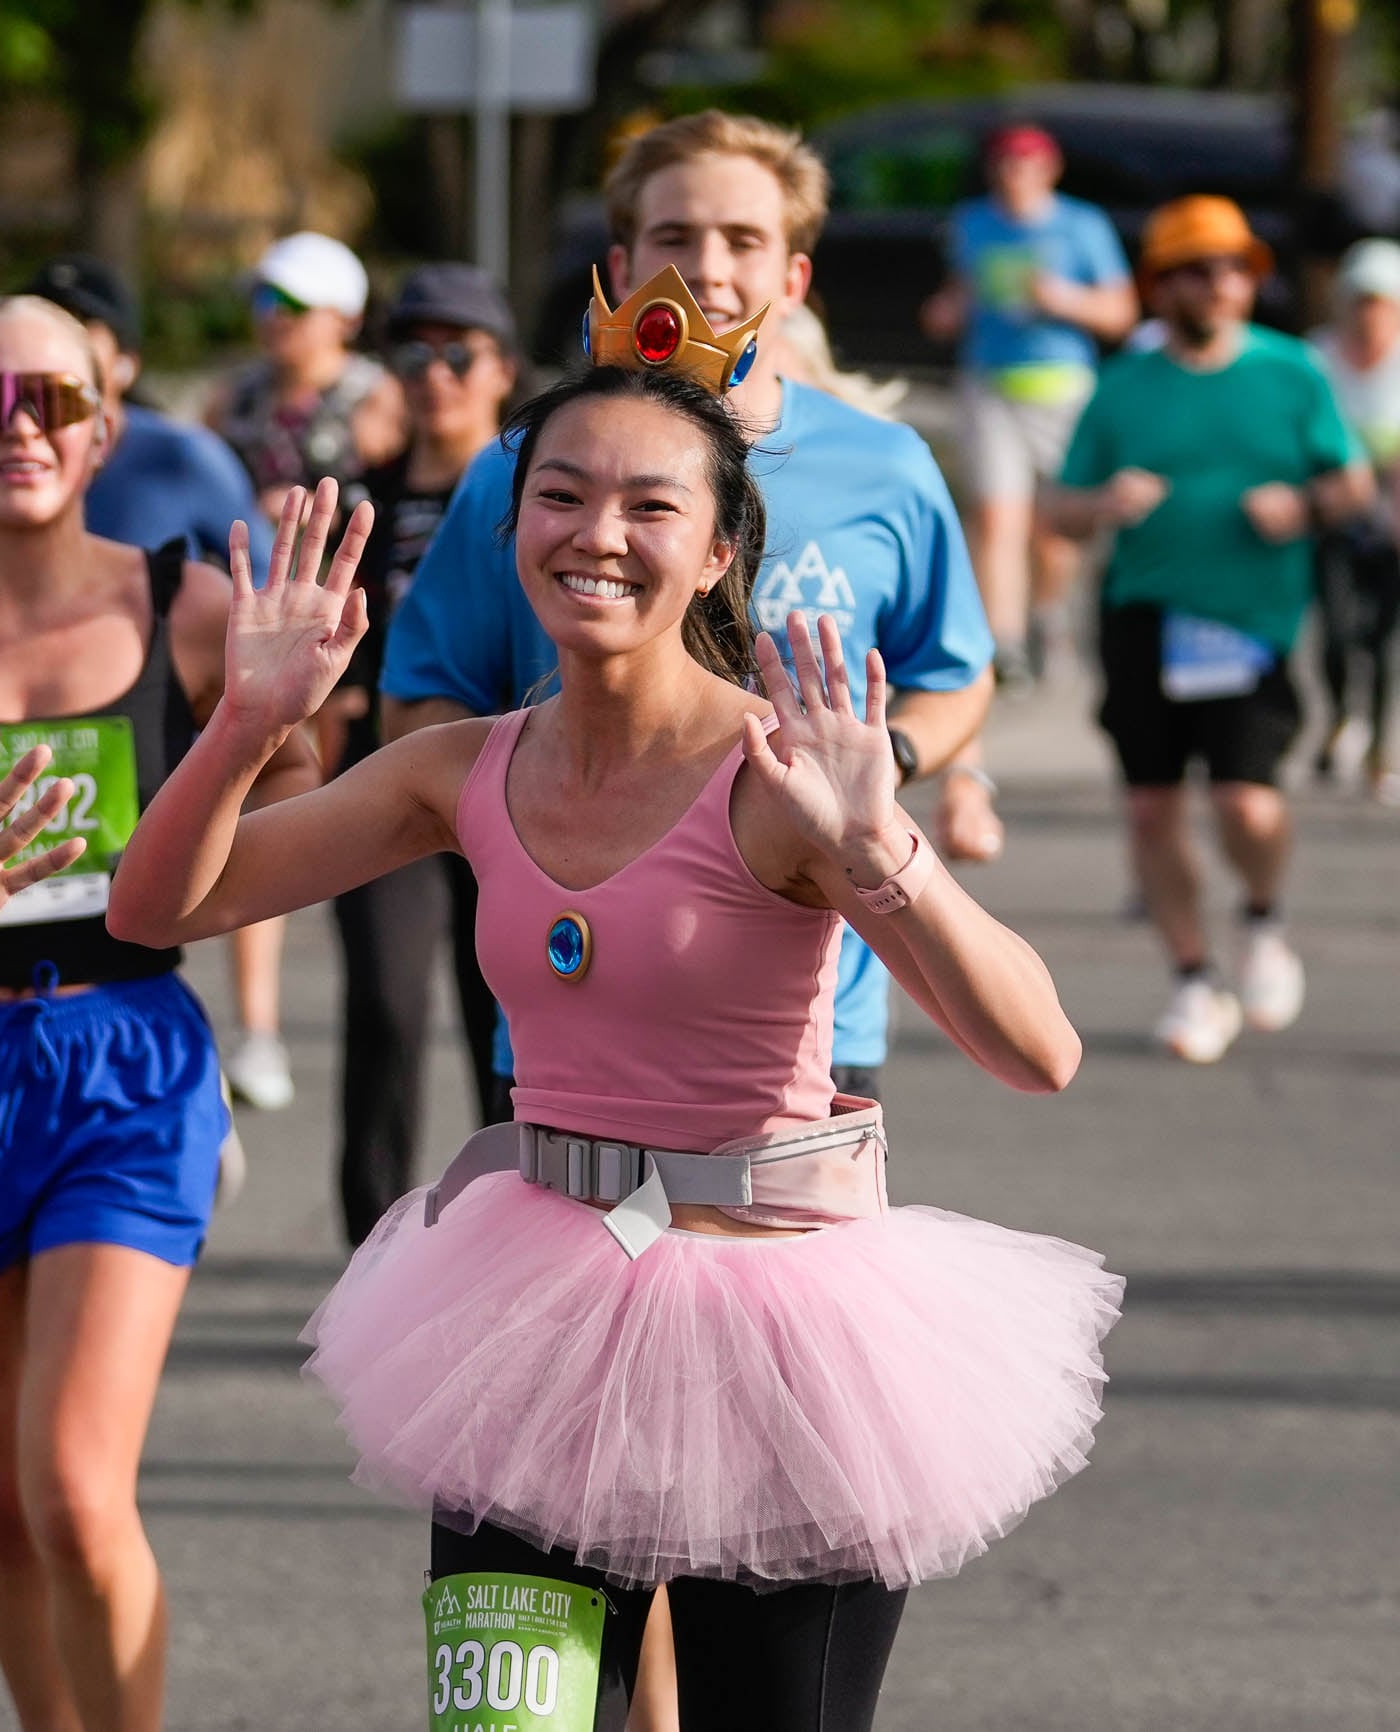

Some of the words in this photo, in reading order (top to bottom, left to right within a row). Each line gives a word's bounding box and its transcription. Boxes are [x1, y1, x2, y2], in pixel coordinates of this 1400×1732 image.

[467, 1584, 499, 1609] SALT
[503, 1585, 539, 1613] LAKE
[542, 1590, 572, 1619] CITY
[465, 1611, 516, 1630] MARATHON
[433, 1640, 560, 1716] 3300
